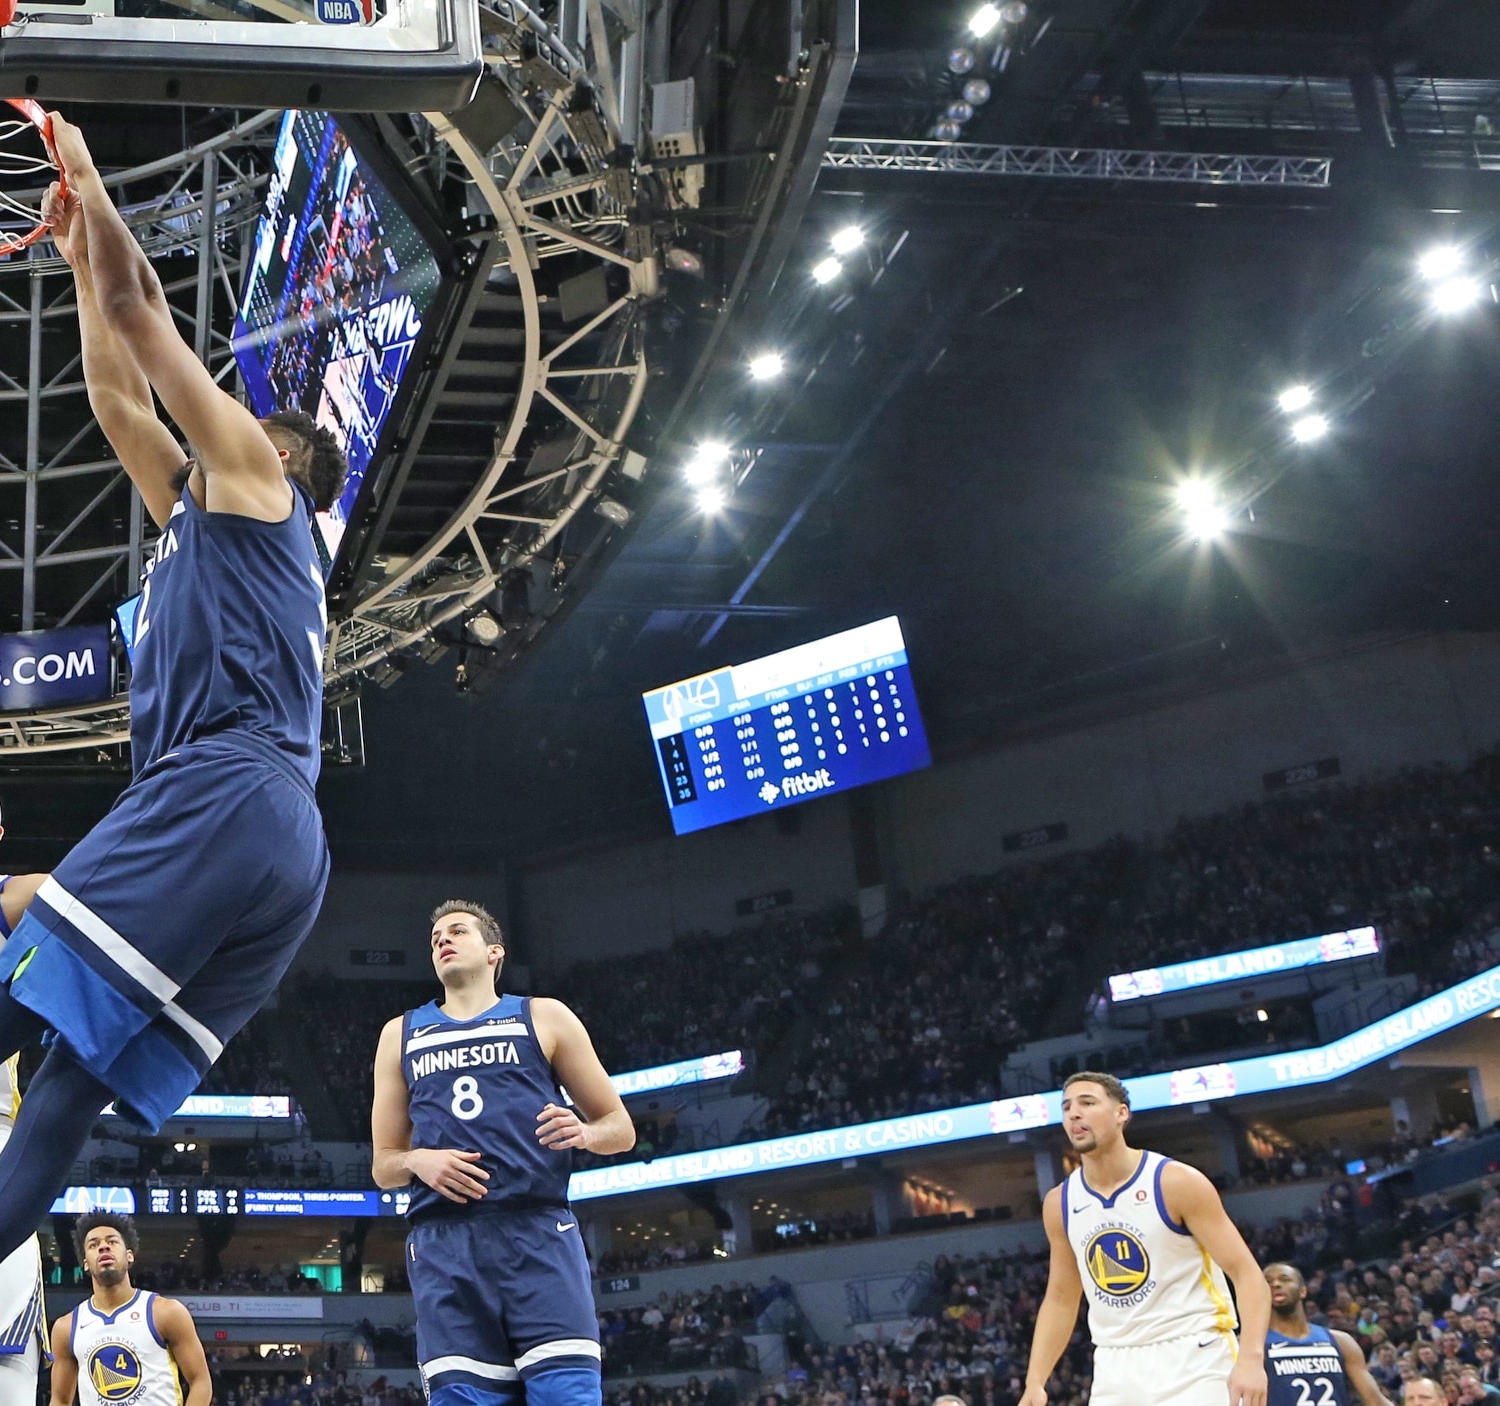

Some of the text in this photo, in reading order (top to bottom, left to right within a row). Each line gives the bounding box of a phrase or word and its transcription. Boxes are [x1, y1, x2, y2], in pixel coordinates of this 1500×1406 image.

[324, 2, 353, 19] NBA
[699, 738, 717, 752] 1/1
[741, 740, 758, 753] 1/1
[1185, 948, 1285, 985] ISLAND
[1268, 1028, 1385, 1082] TREASURE
[1384, 998, 1454, 1046] ISLAND
[411, 1041, 520, 1081] MINNESOTA
[451, 1075, 484, 1120] 8
[225, 1105, 248, 1114] TIME
[571, 1114, 954, 1193] TREASURE ISLAND RESORT & CASINO
[1080, 1221, 1146, 1247] GOLDEN STATE
[1115, 1240, 1131, 1261] 11
[1093, 1279, 1157, 1308] WARRIORS
[187, 1302, 221, 1312] CLUB
[115, 1353, 128, 1370] 4
[1273, 1357, 1343, 1376] MINNESOTA
[1291, 1377, 1337, 1406] 22
